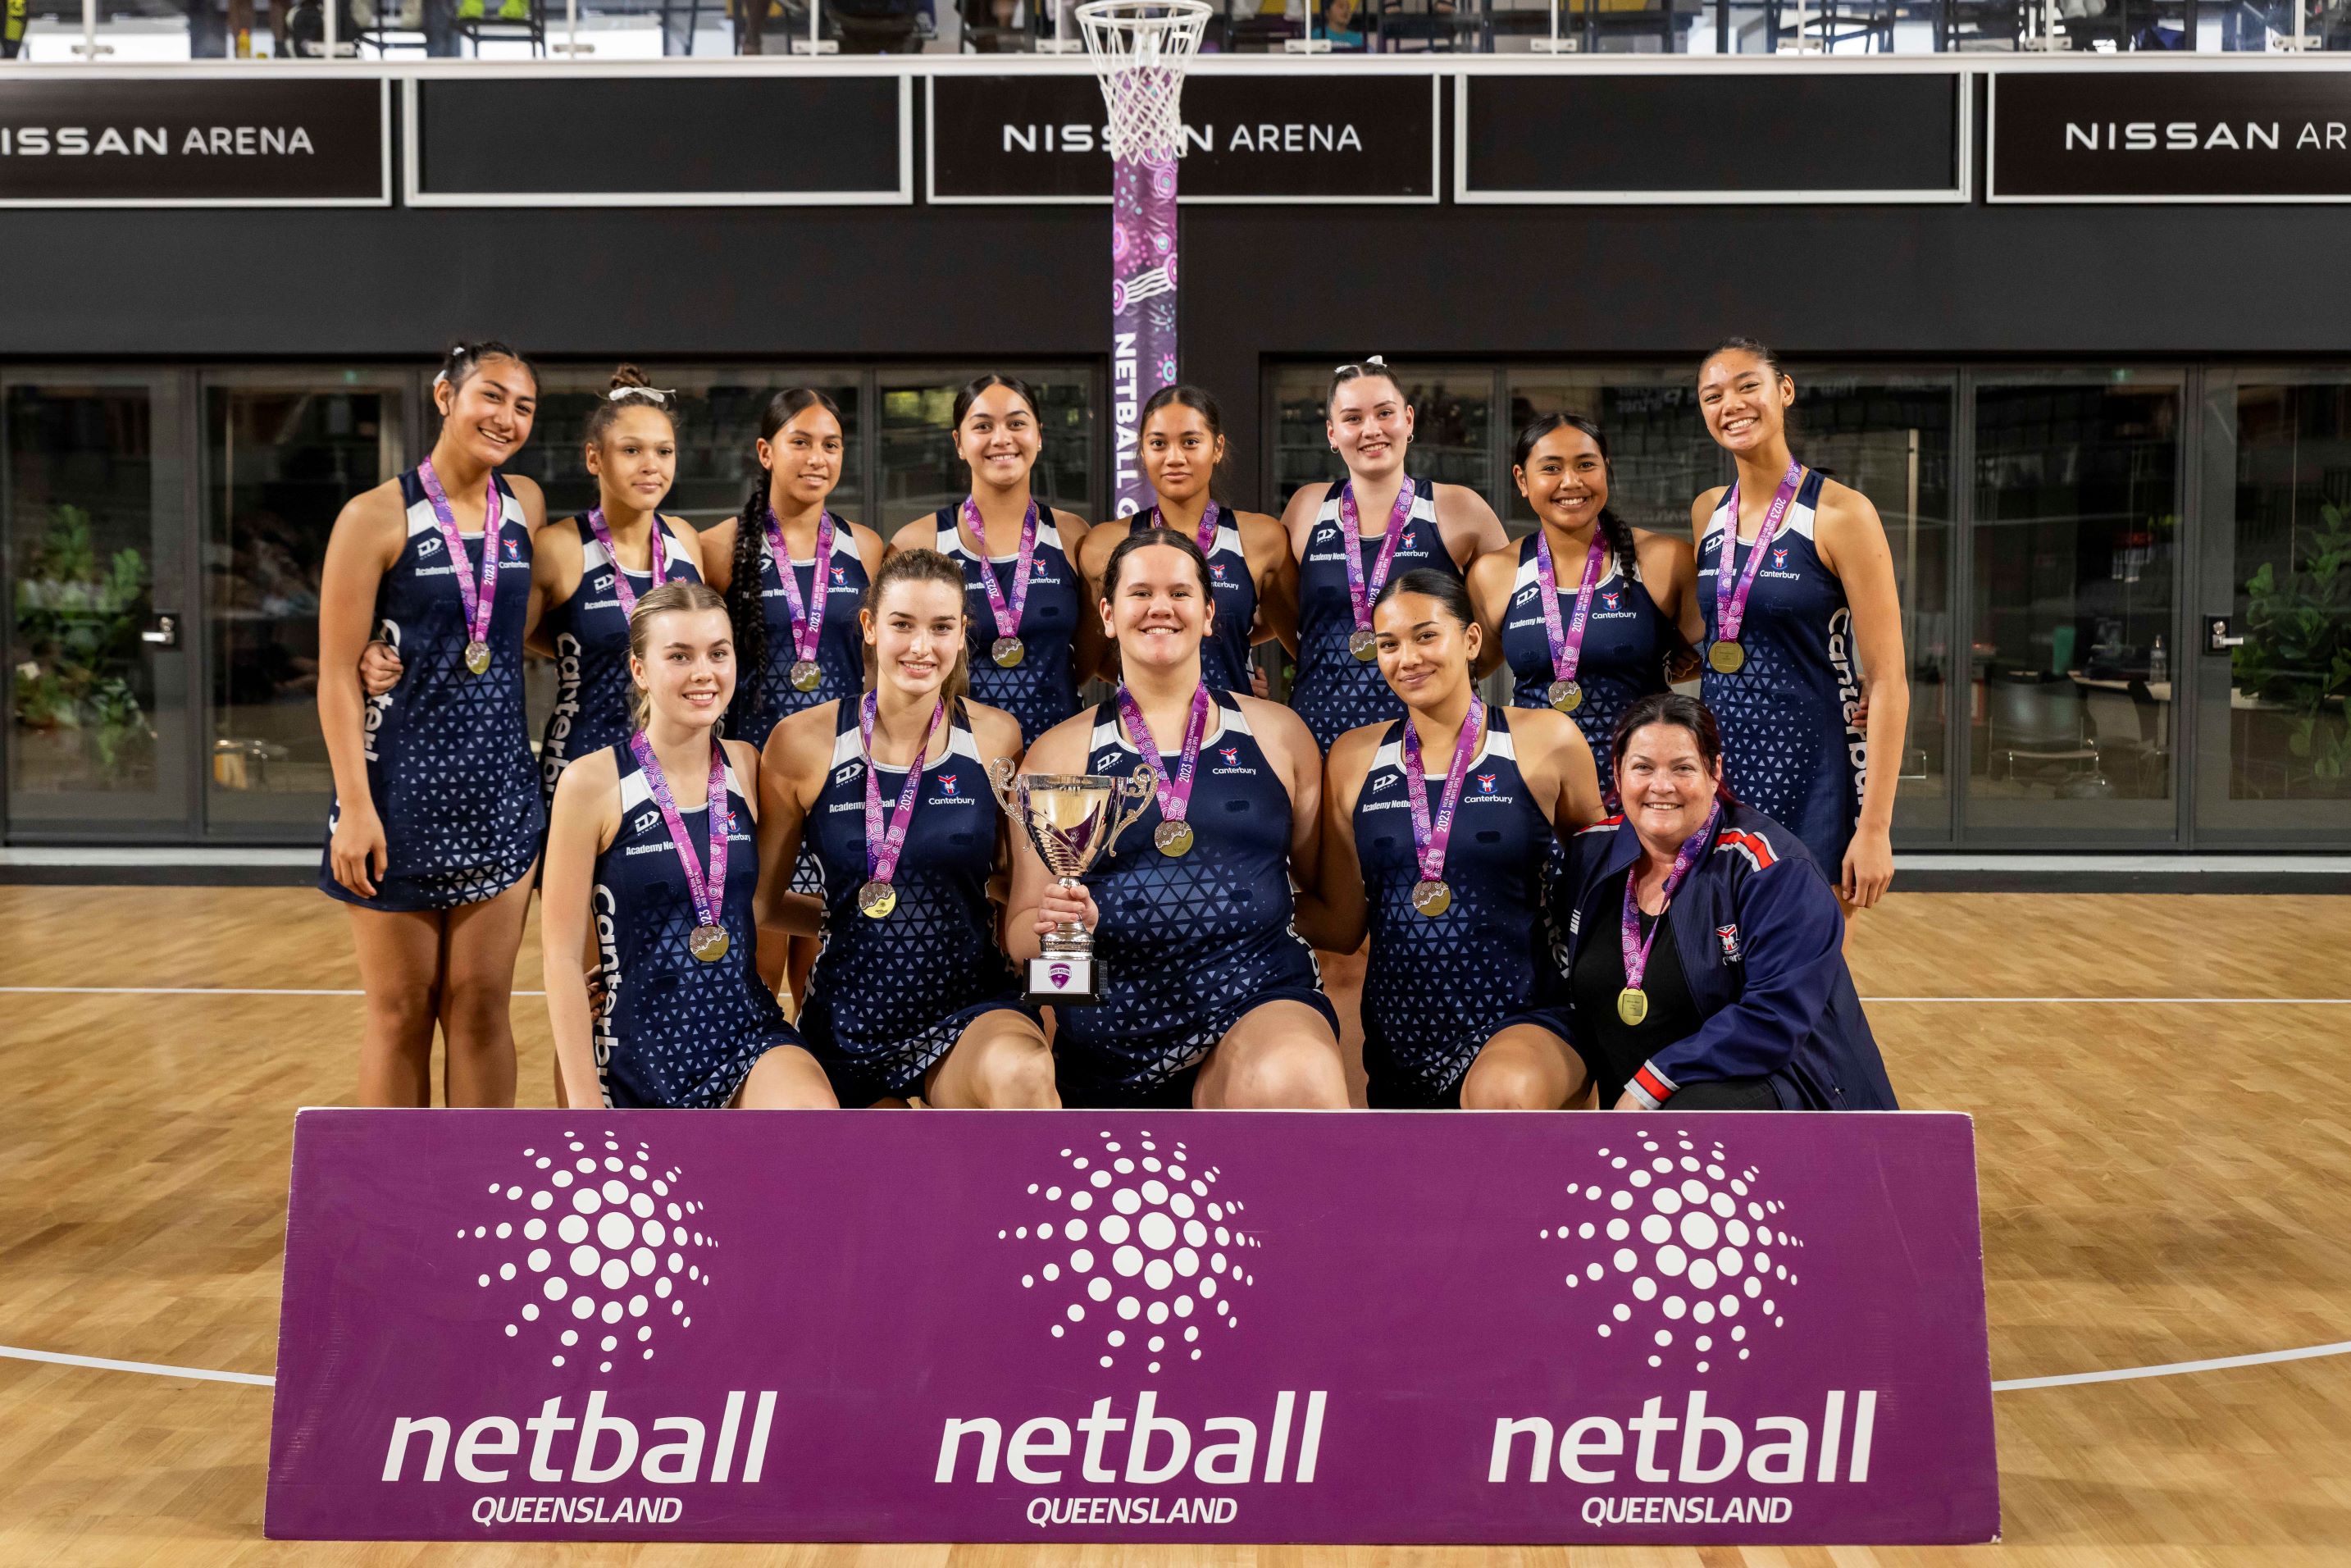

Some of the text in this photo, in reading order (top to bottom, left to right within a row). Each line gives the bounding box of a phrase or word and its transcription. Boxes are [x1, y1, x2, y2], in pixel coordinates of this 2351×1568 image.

[181, 127, 314, 155] ARENA
[1003, 124, 1362, 152] NISN ARENA
[2066, 122, 2279, 150] NISSAN
[1114, 332, 1139, 489] NETBALL
[1770, 497, 1786, 520] 2023
[1310, 553, 1333, 562] Academy
[484, 564, 495, 586] 2023
[1760, 569, 1801, 581] Canterbury
[986, 578, 1000, 599] 2023
[585, 599, 620, 610] Academy
[809, 612, 821, 633] 2023
[1510, 618, 1536, 630] Academy
[1572, 613, 1584, 633] 2023
[1592, 611, 1637, 620] Canterbury
[543, 632, 581, 808] Canterb
[1178, 763, 1193, 783] 2023
[1213, 766, 1256, 776] Canterbury
[829, 800, 866, 813] Academy
[899, 789, 914, 812] 2023
[928, 796, 975, 805] Canterbury
[1363, 801, 1390, 813] Academy
[1464, 794, 1513, 805] Canterbury
[1436, 810, 1451, 832] 2023
[726, 832, 751, 843] nterbury
[626, 843, 663, 856] Academy
[699, 909, 713, 927] 023
[591, 884, 622, 1109] Canterbu
[382, 1391, 777, 1483] netball
[935, 1391, 1327, 1484] netball
[1488, 1391, 1876, 1484] netball
[472, 1497, 682, 1526] QUEENSLAND
[1027, 1497, 1237, 1528] QUEENSLAND
[1582, 1497, 1792, 1527] QUEENSLAND
